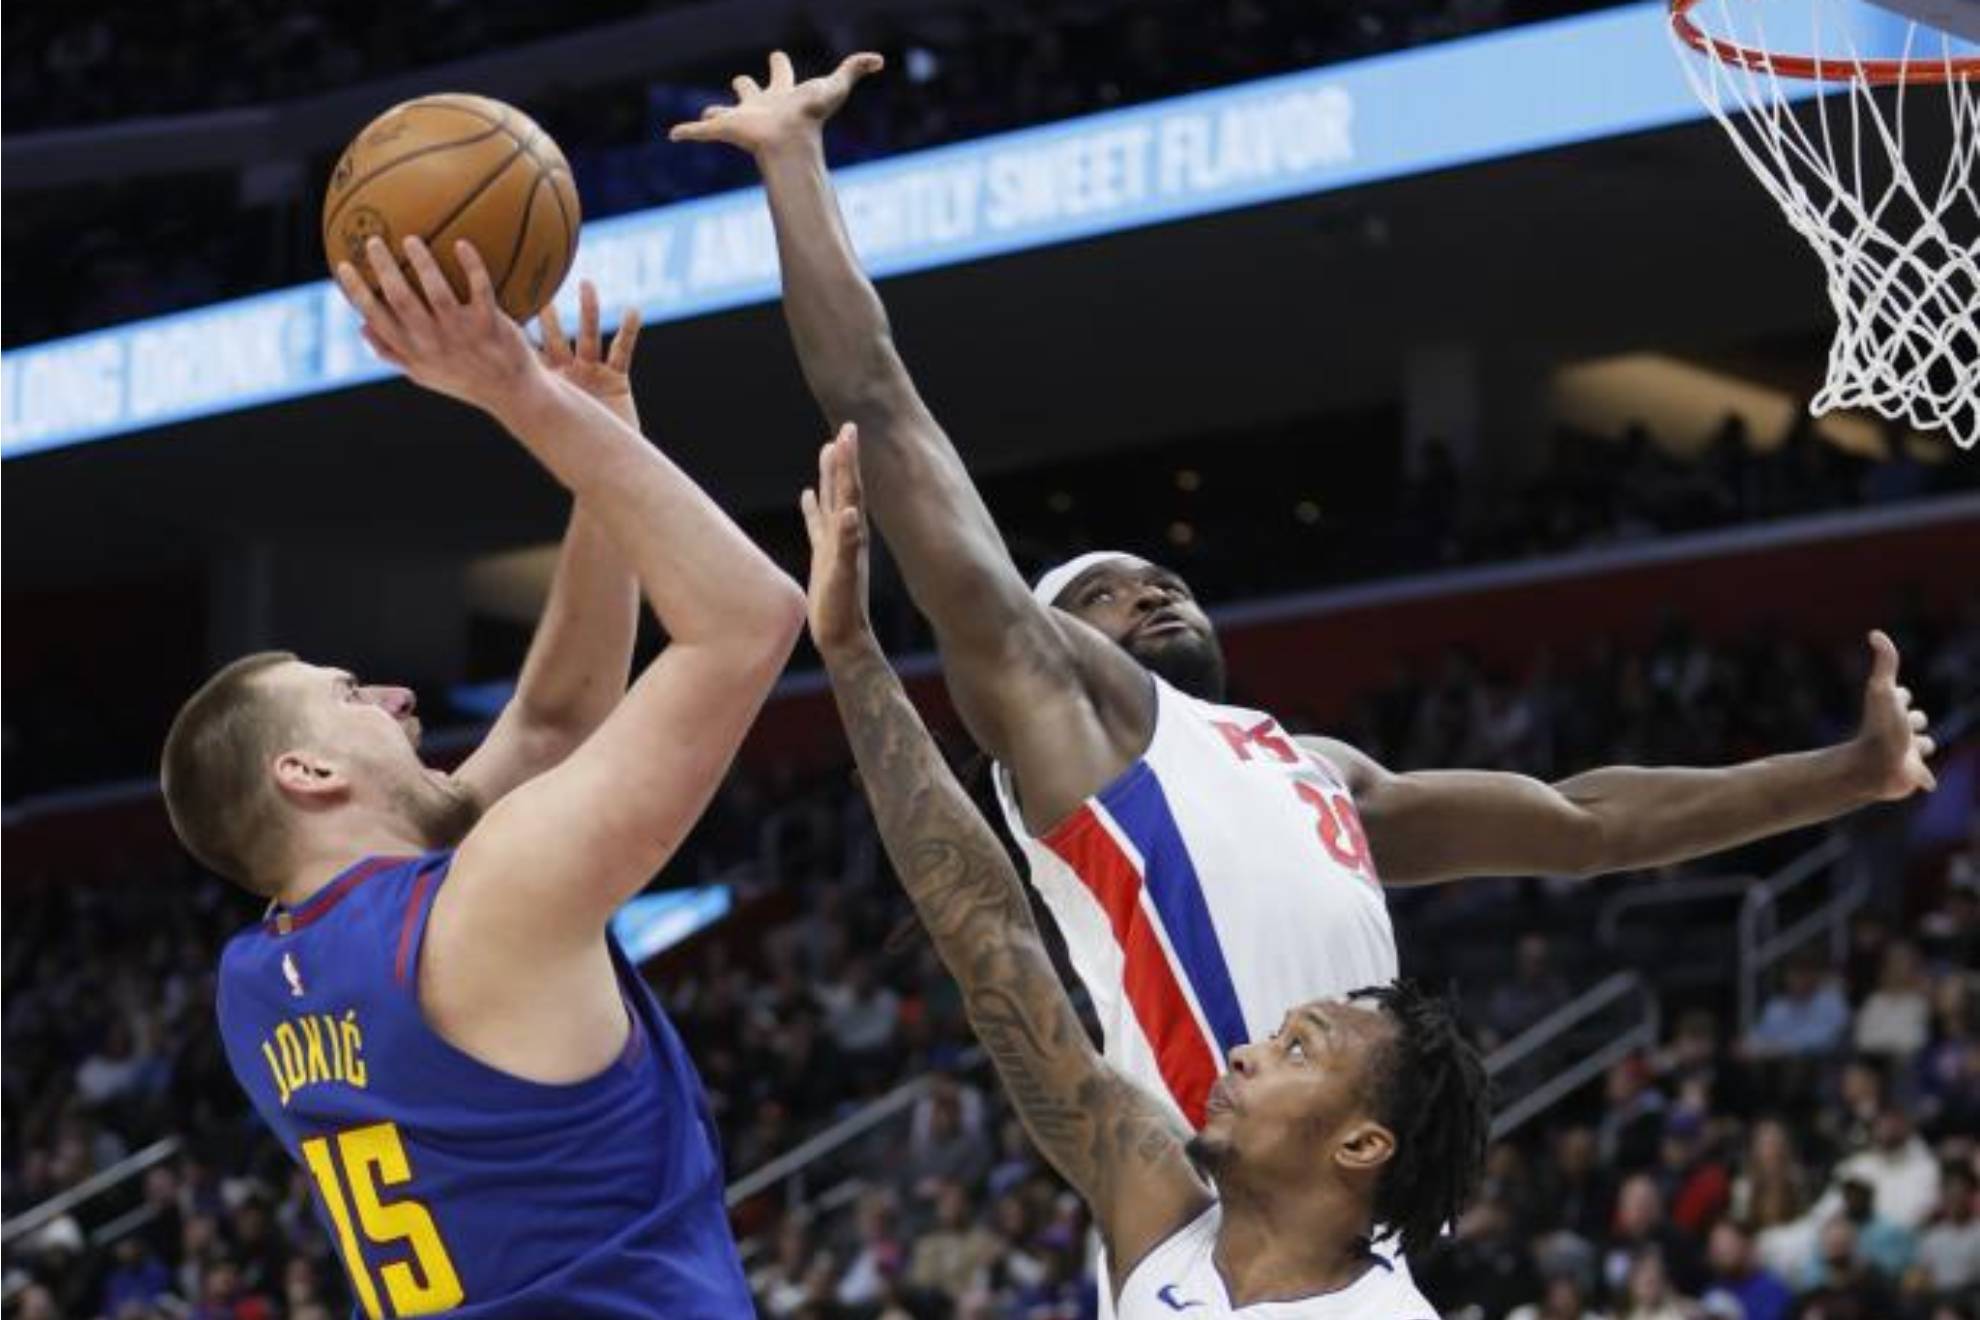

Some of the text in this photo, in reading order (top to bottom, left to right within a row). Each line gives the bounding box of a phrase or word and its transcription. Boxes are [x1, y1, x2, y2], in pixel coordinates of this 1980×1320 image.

[130, 303, 288, 415] DRINK
[985, 129, 1152, 232] SWEET
[1160, 87, 1351, 194] FLAVOR
[262, 1009, 367, 1107] JOKIĆ
[302, 1121, 465, 1319] 15
